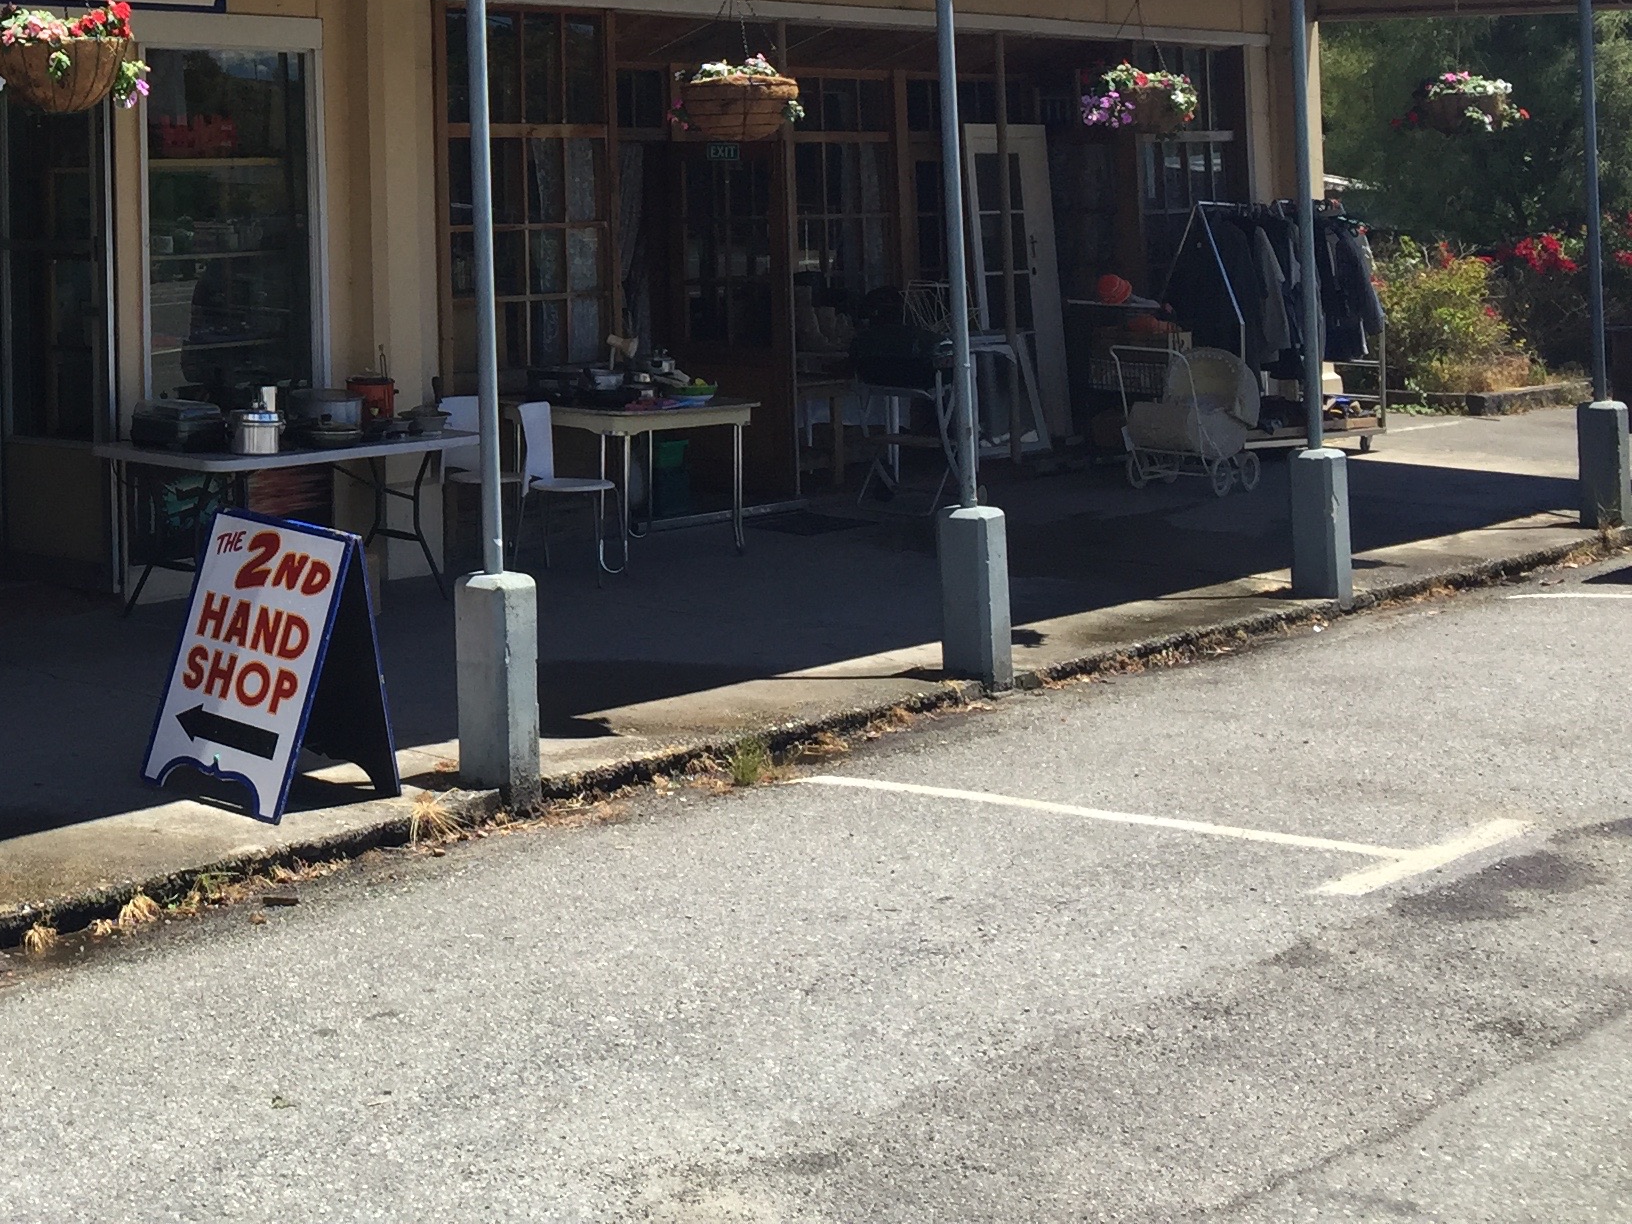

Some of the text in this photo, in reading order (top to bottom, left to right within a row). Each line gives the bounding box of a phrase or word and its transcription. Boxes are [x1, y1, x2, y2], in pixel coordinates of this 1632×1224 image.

[710, 146, 735, 157] EXIT
[217, 530, 331, 596] THE 2ND
[196, 590, 310, 661] HAND
[182, 644, 299, 714] SHOP
